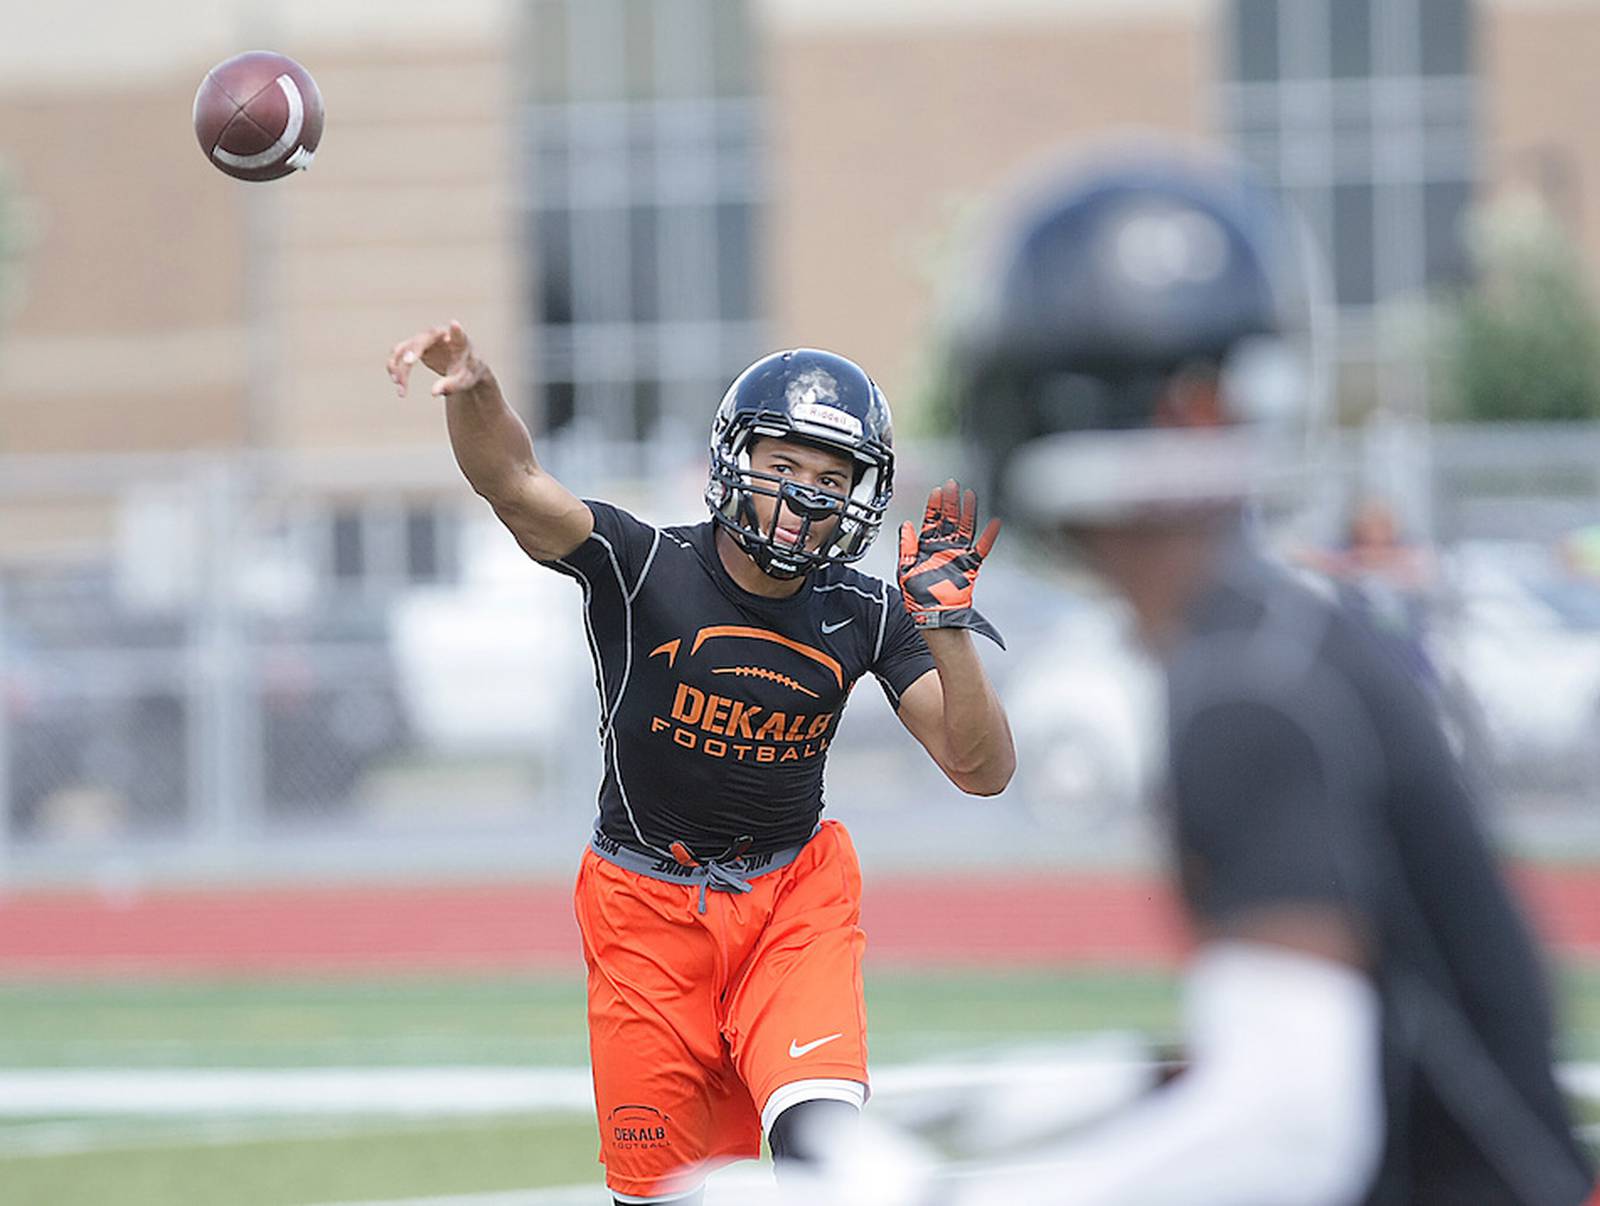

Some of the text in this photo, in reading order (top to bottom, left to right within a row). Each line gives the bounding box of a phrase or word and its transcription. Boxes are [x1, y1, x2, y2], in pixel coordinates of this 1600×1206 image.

[671, 682, 834, 742] DEKALB
[652, 717, 829, 763] FOOTBALL
[651, 859, 695, 877] NIKE
[745, 853, 775, 873] NIK
[614, 1126, 665, 1141] DEKALB
